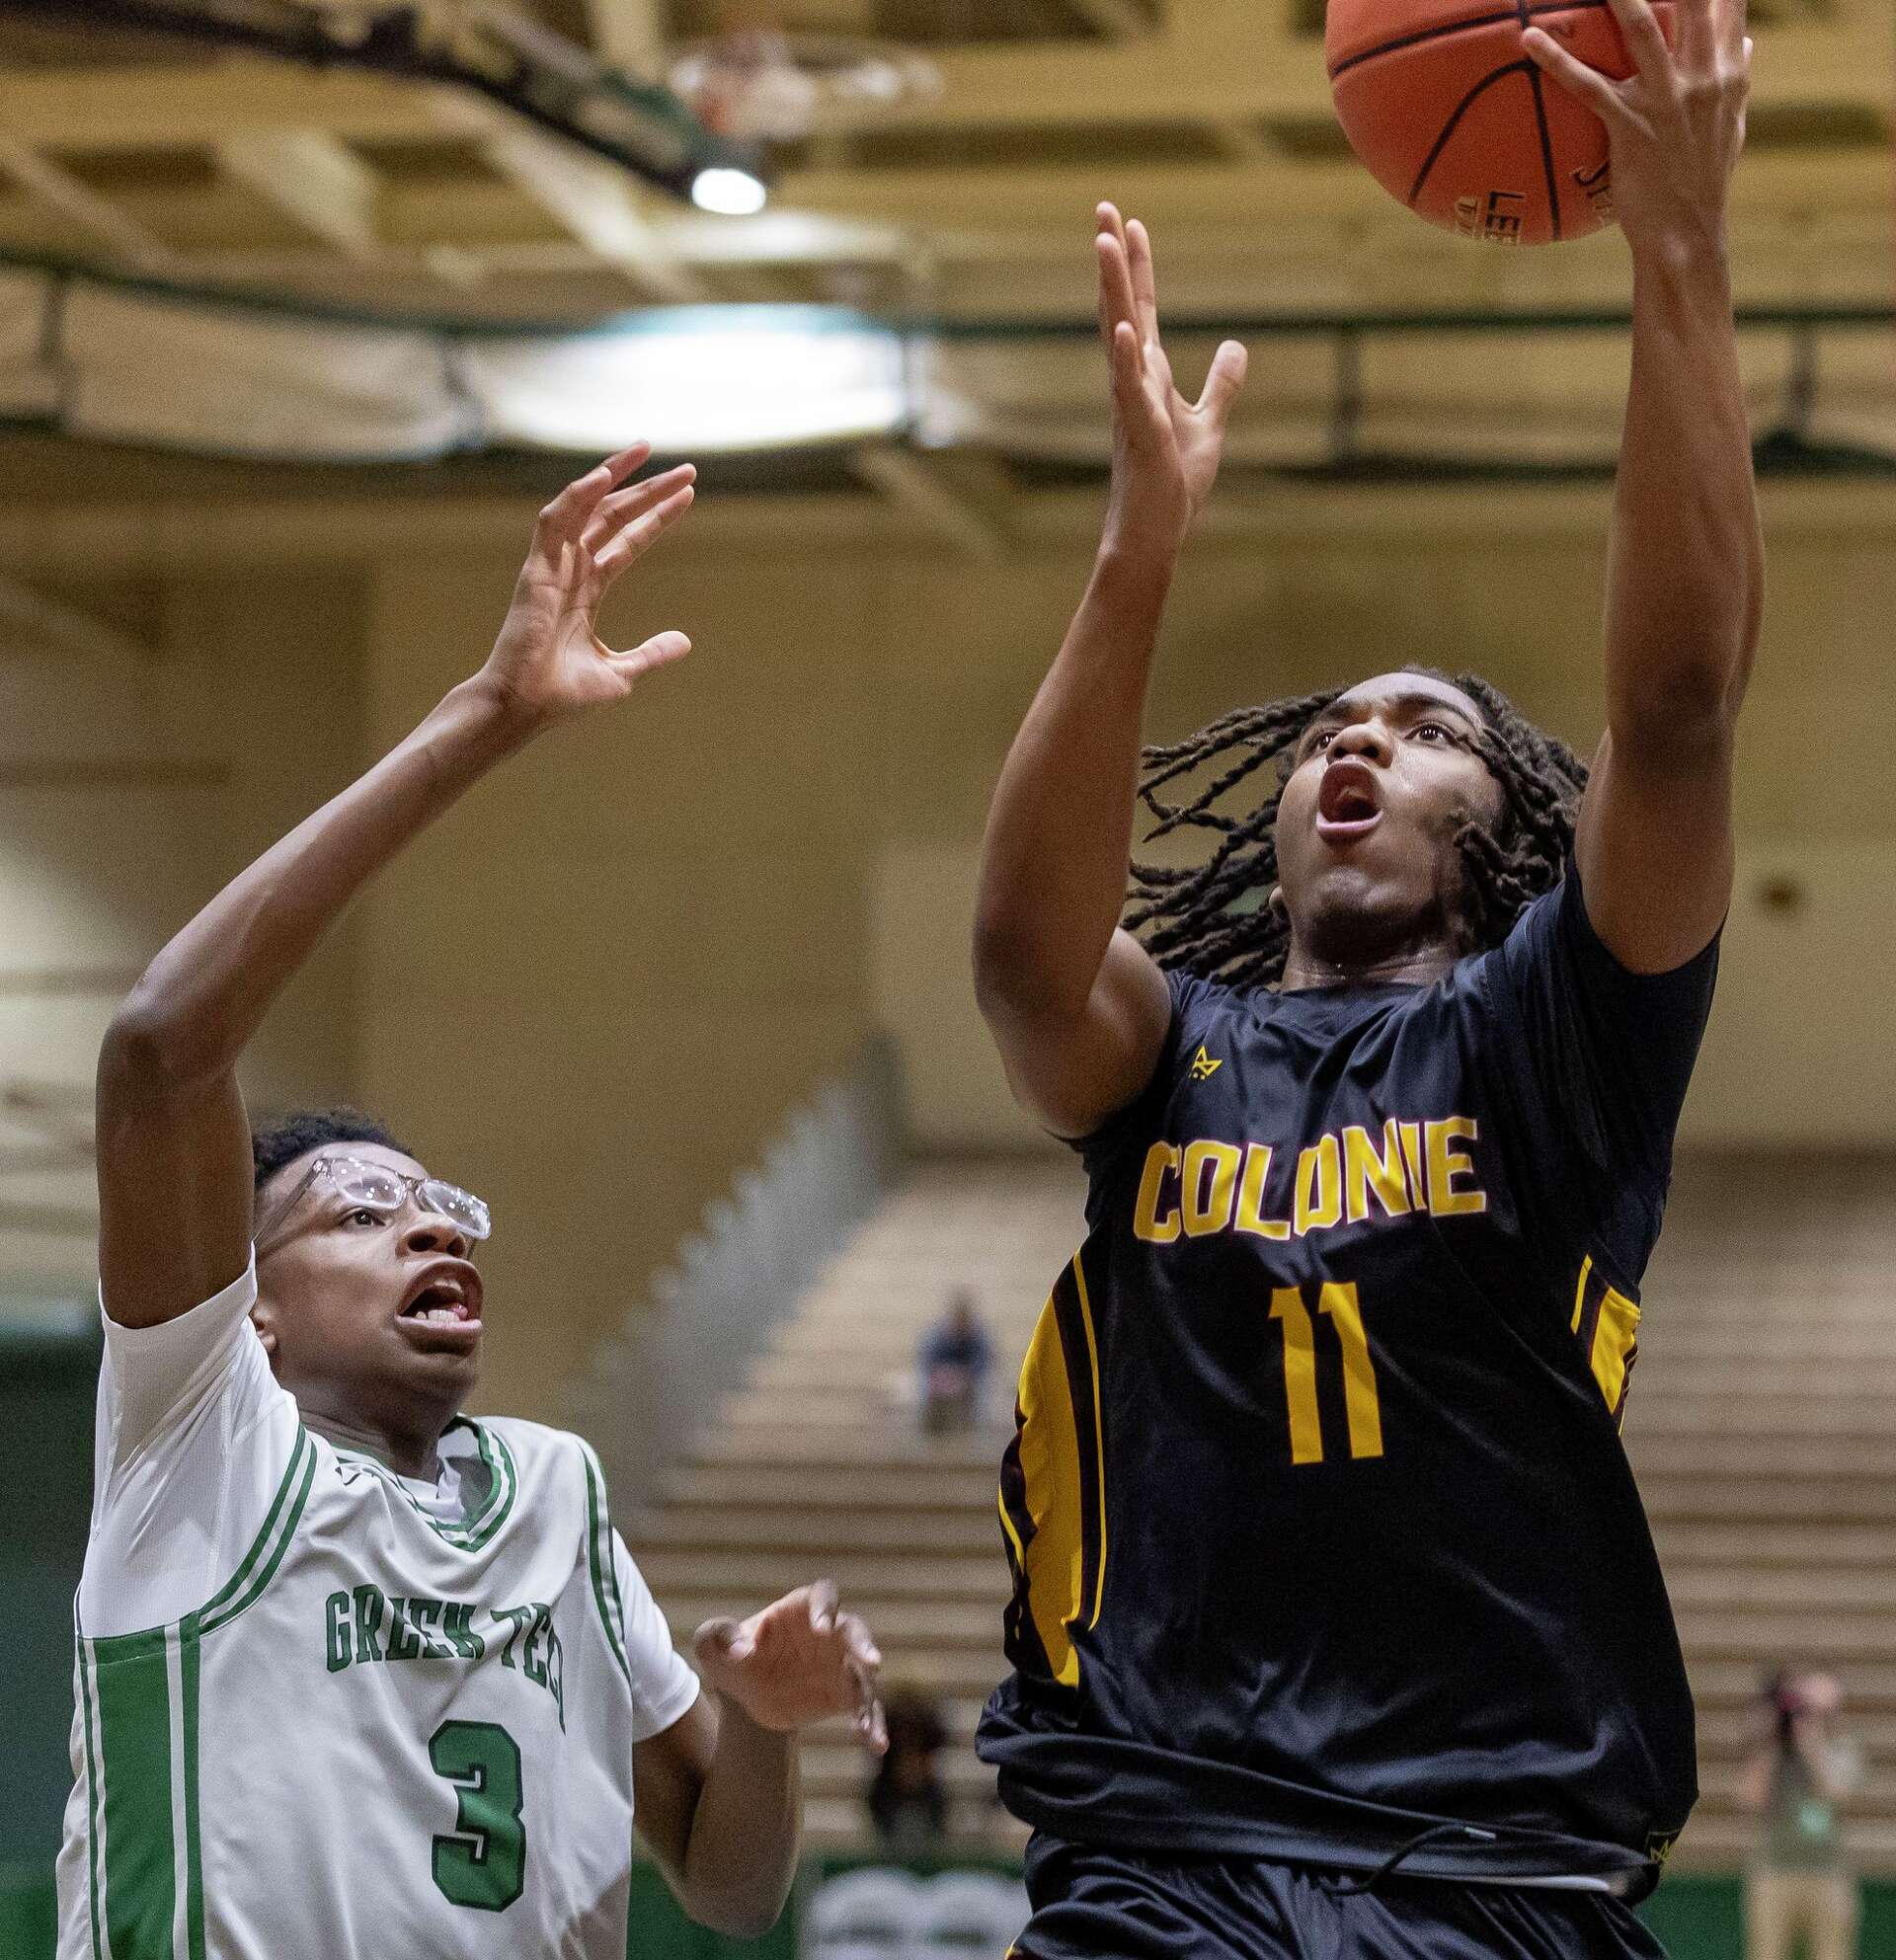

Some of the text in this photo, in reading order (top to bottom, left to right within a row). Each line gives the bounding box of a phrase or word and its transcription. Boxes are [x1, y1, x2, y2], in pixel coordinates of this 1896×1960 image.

[1133, 1115, 1487, 1244] COLONIE
[1268, 1281, 1383, 1465] 11
[326, 1583, 486, 1674] GREEN
[428, 1719, 527, 1914] 3
